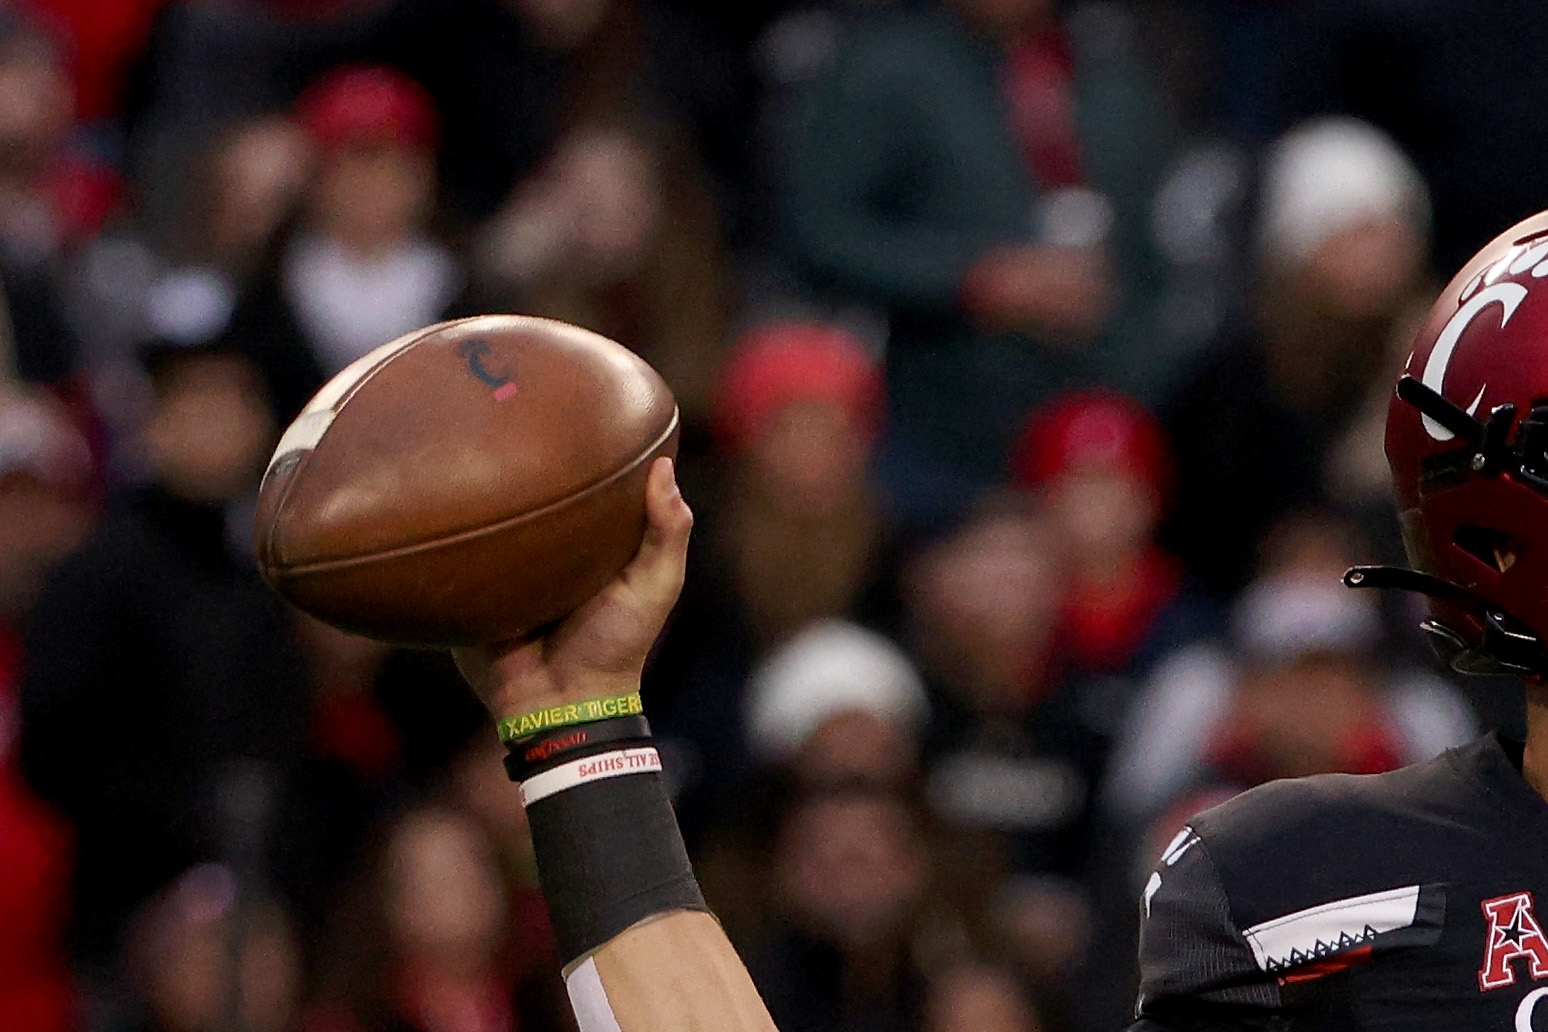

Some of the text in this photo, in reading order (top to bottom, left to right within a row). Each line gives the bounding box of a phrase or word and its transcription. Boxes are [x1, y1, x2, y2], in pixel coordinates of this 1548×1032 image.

[506, 706, 580, 738] XAVIER
[578, 756, 625, 778] SHIPS
[625, 753, 648, 767] ALL
